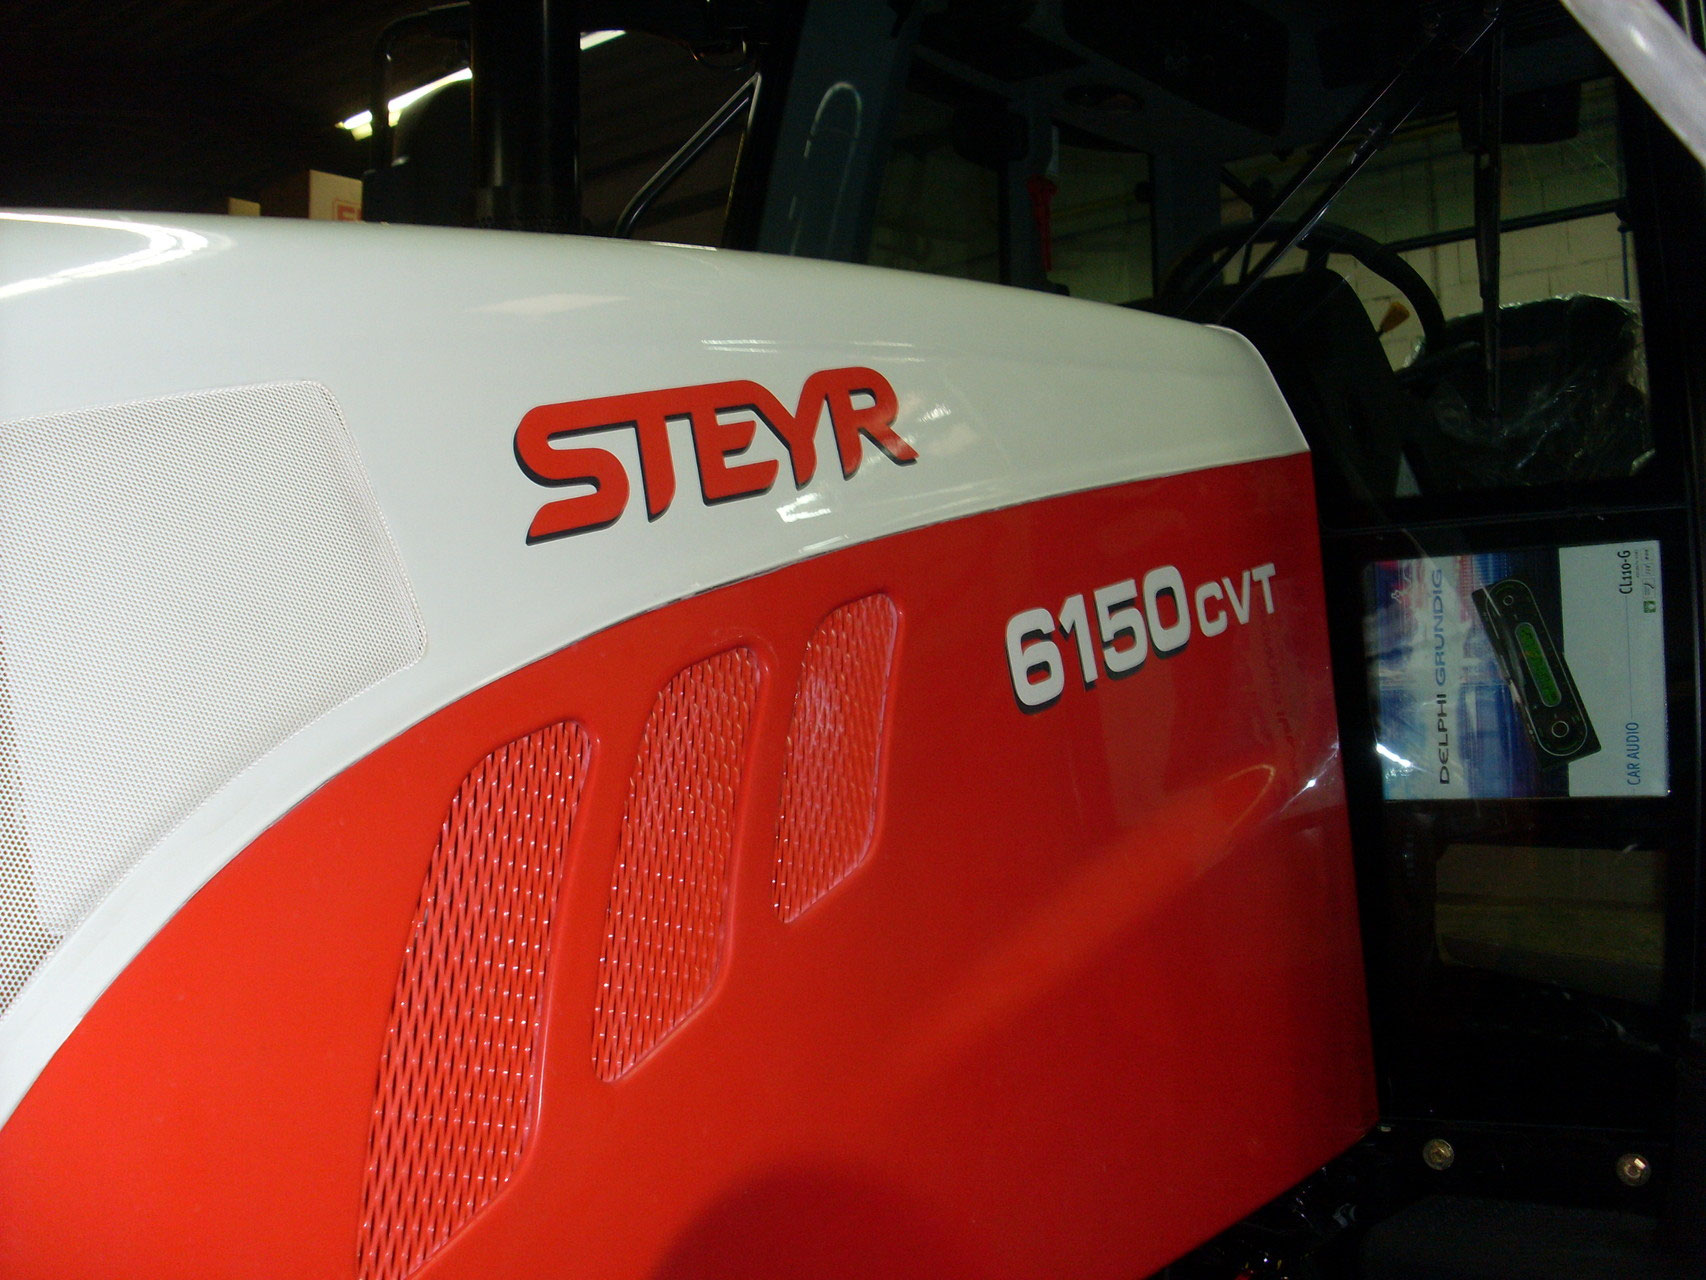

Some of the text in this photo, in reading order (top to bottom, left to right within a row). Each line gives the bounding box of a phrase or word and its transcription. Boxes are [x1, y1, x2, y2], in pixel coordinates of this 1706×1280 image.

[513, 366, 919, 546] STEYR
[1005, 565, 1191, 715] 6150
[1431, 568, 1450, 785] DELPHI GRUNDIG
[1625, 722, 1641, 786] CAR AUDIO
